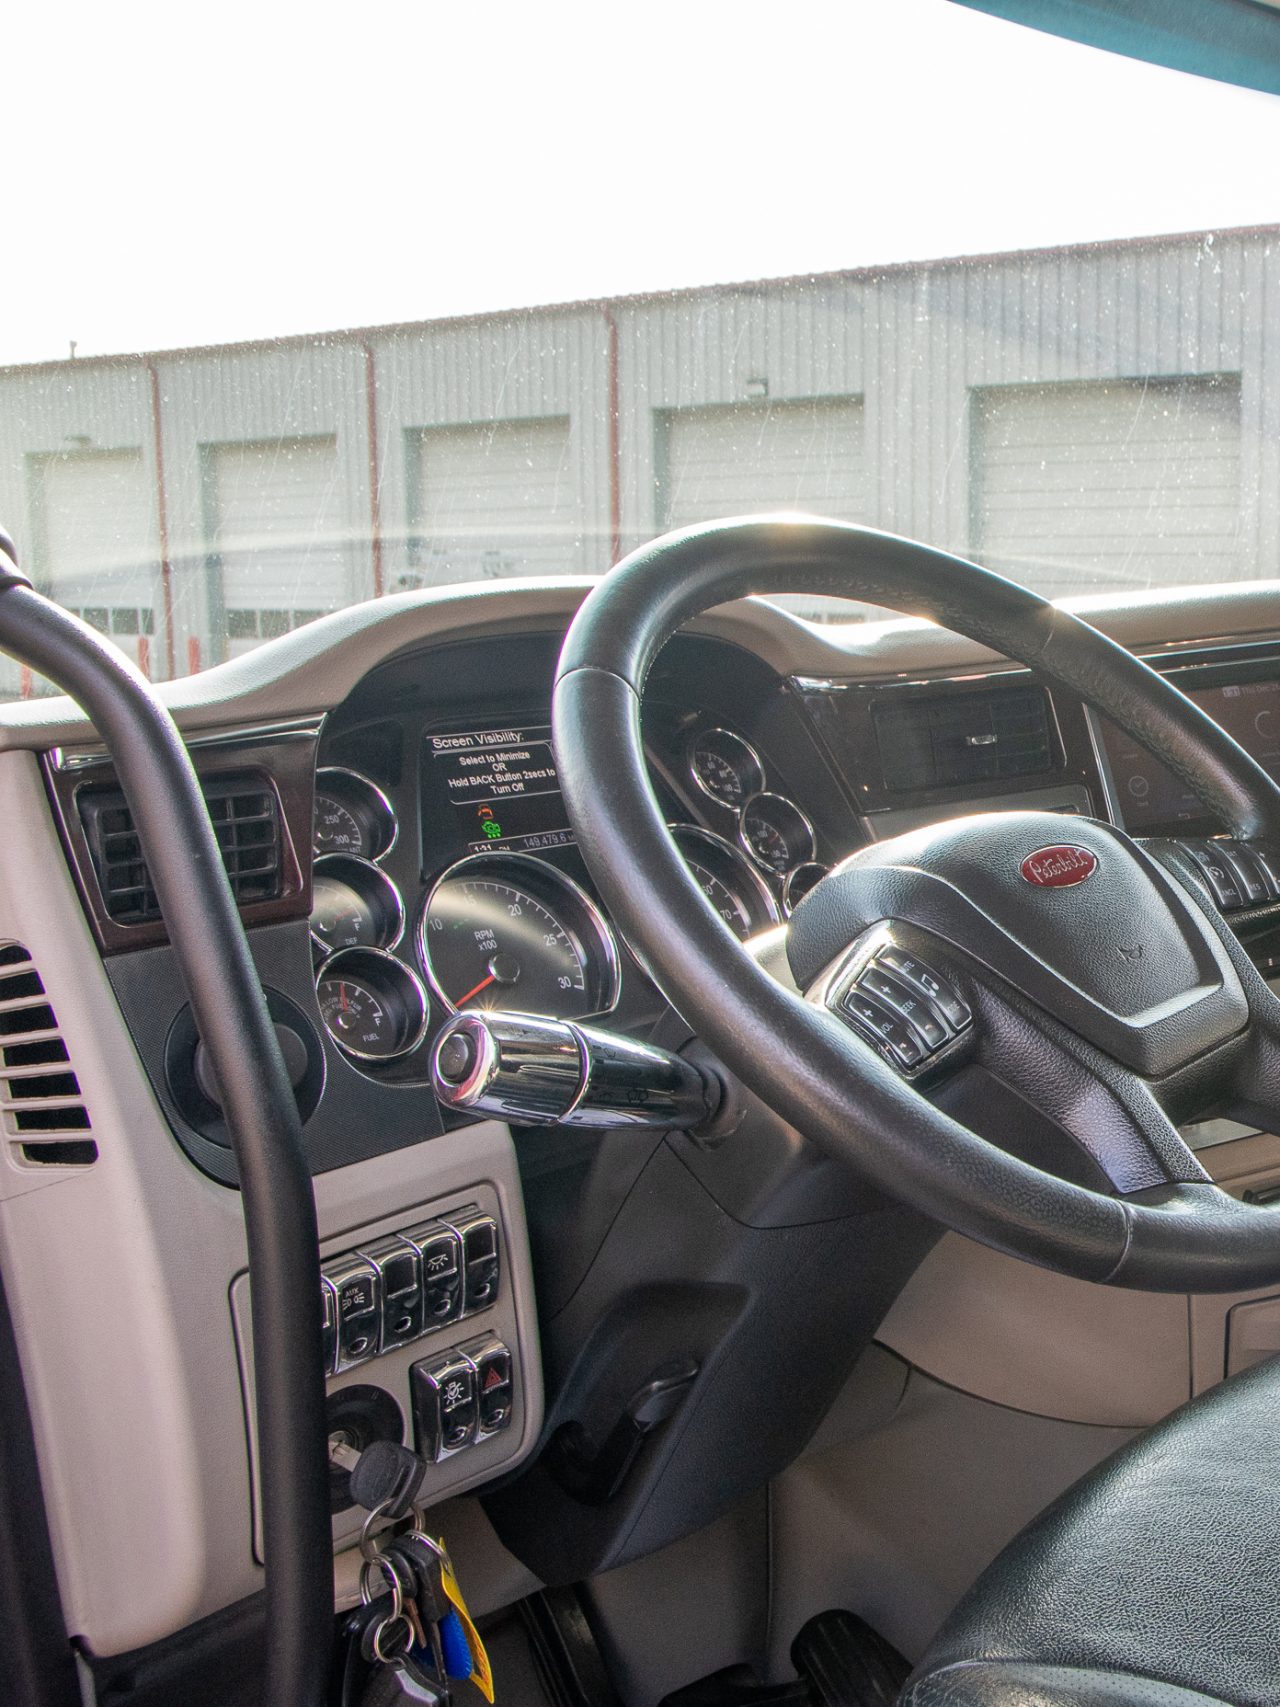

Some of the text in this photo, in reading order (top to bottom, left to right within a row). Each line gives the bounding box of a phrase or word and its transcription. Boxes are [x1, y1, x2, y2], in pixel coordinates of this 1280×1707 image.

[432, 731, 525, 749] Screen Visibility:
[459, 751, 531, 766] Select to Minimize
[492, 762, 507, 772] OR
[448, 768, 556, 789] Hold BACK Button 2secs to
[490, 782, 525, 795] Turn Off
[324, 814, 340, 824] 250
[334, 835, 350, 845] 300
[1028, 848, 1091, 883] Peterbilt
[507, 904, 522, 917] 20
[429, 918, 443, 931] 10
[474, 929, 495, 942] RPM
[543, 934, 557, 947] 25
[478, 940, 498, 951] x100
[557, 976, 572, 990] 30
[374, 1017, 381, 1027] F
[362, 1032, 380, 1042] FUEL
[345, 1287, 360, 1298] AUX
